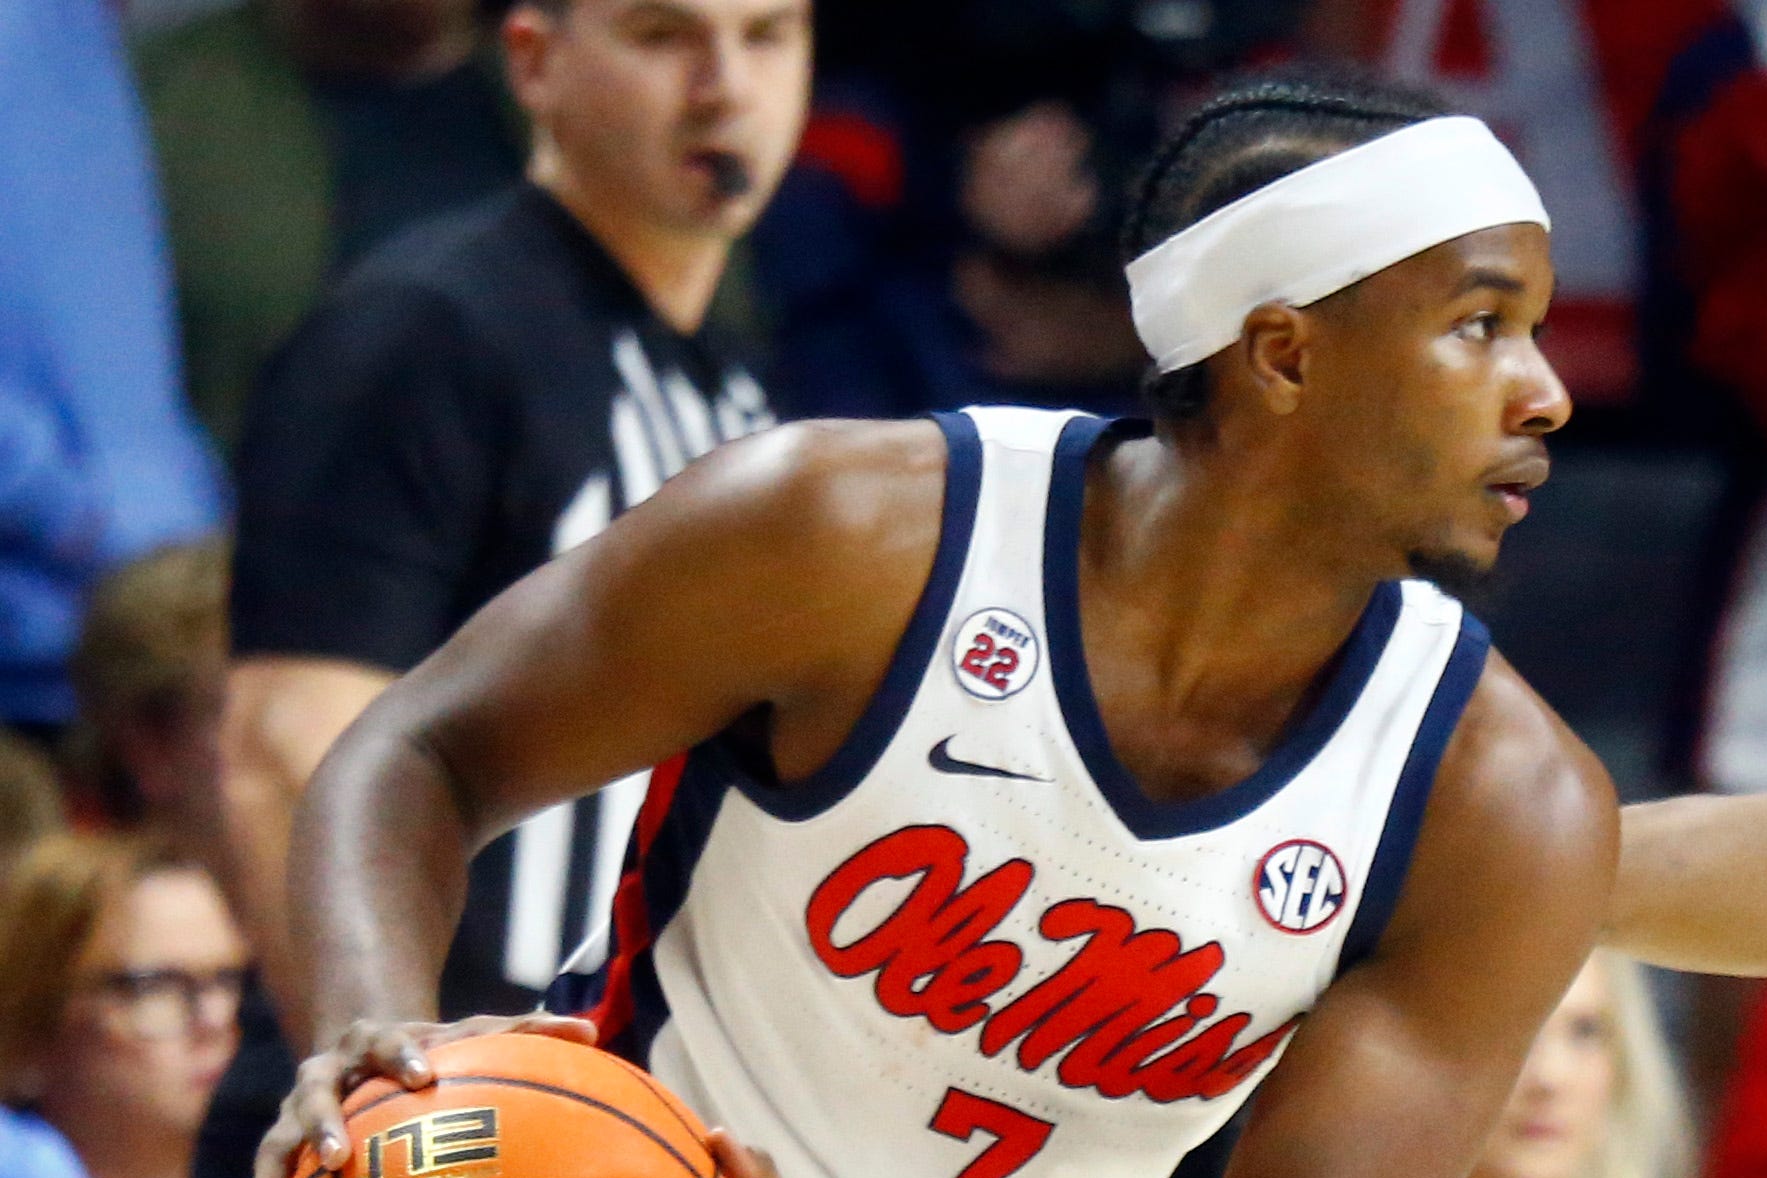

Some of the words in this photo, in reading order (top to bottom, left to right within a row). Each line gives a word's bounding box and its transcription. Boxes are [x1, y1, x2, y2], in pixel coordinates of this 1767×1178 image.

[960, 632, 1019, 691] 22
[805, 824, 1034, 1034] Ole
[1257, 842, 1344, 930] SEC
